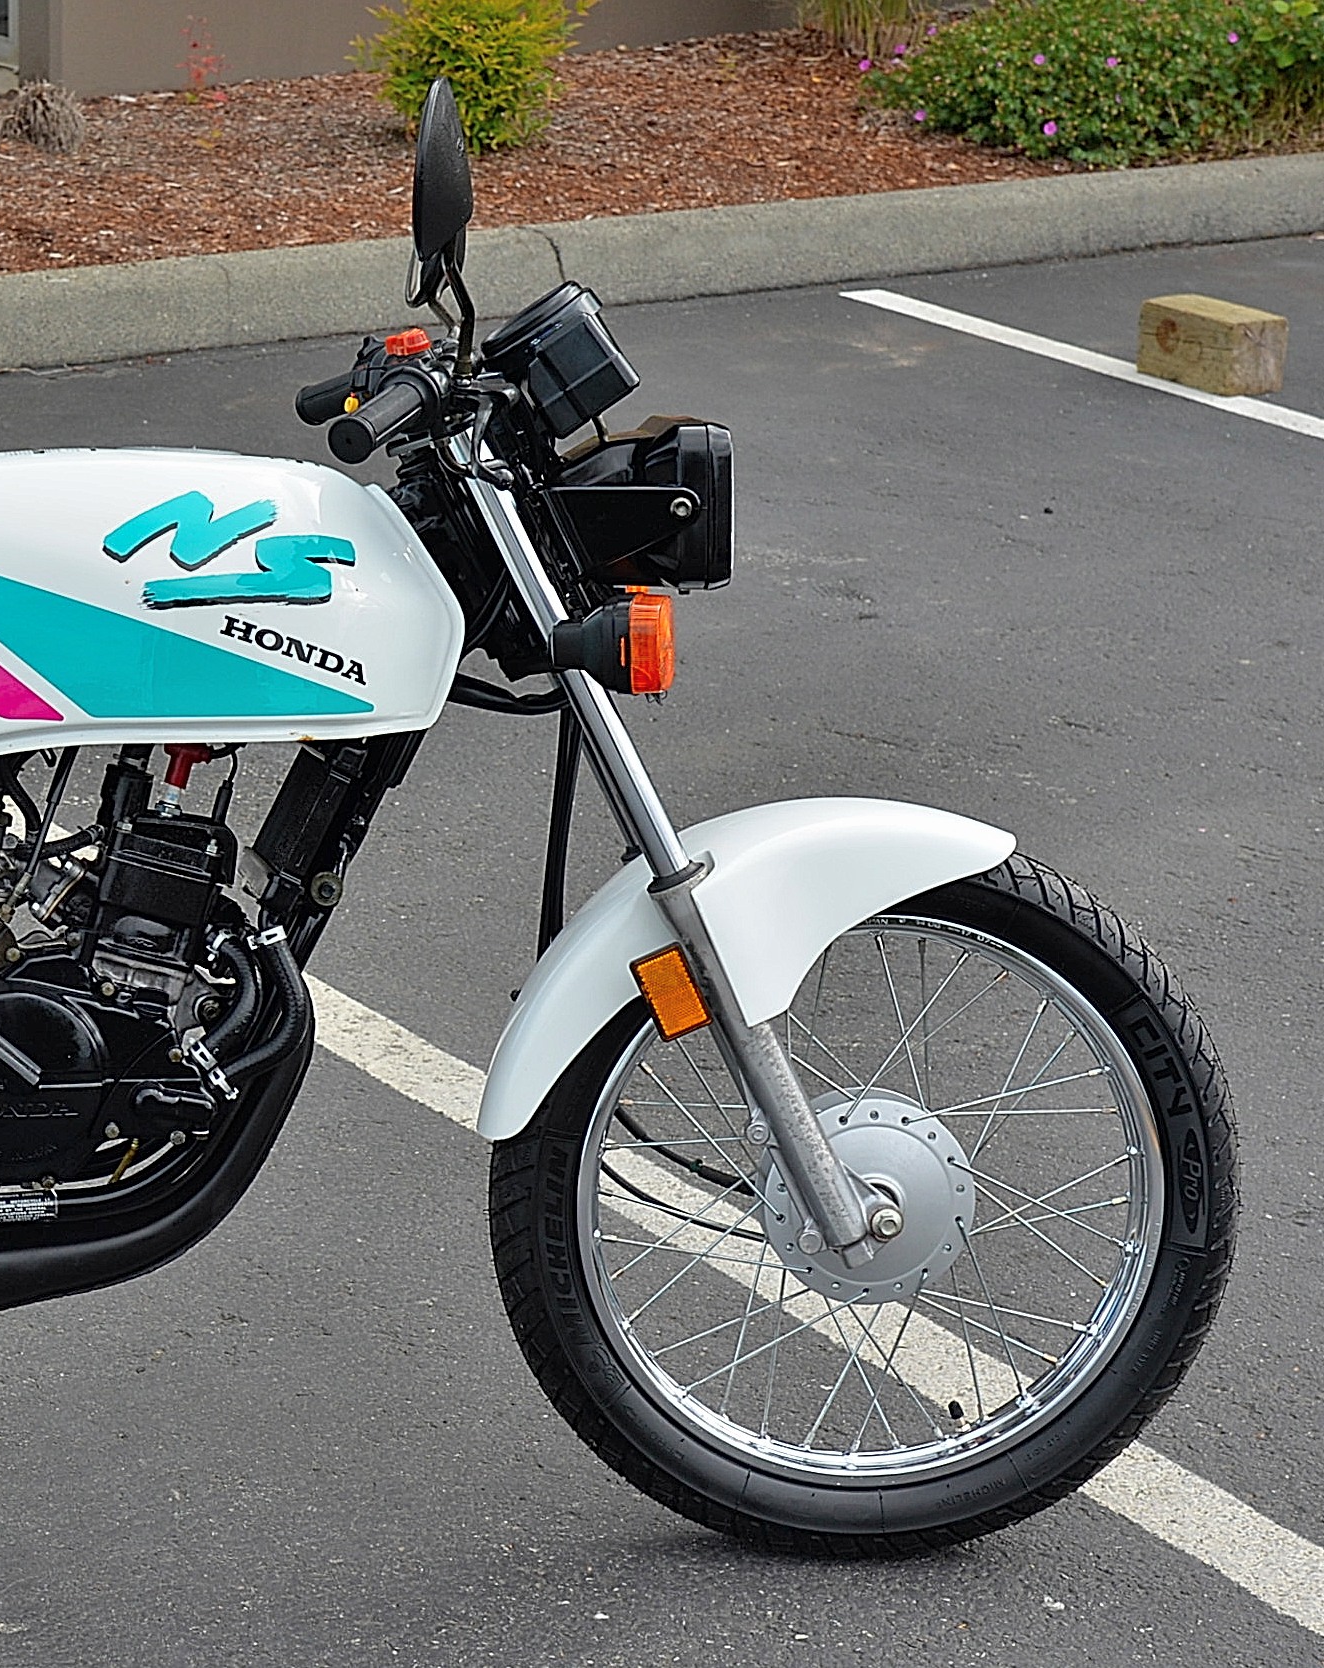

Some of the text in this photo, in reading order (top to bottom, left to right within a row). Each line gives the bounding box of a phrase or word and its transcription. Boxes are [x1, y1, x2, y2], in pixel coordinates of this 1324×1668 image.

[102, 490, 356, 610] NS
[220, 615, 367, 686] HONDA
[1128, 1014, 1203, 1202] CITY Pro
[545, 1146, 586, 1340] MICHELIN
